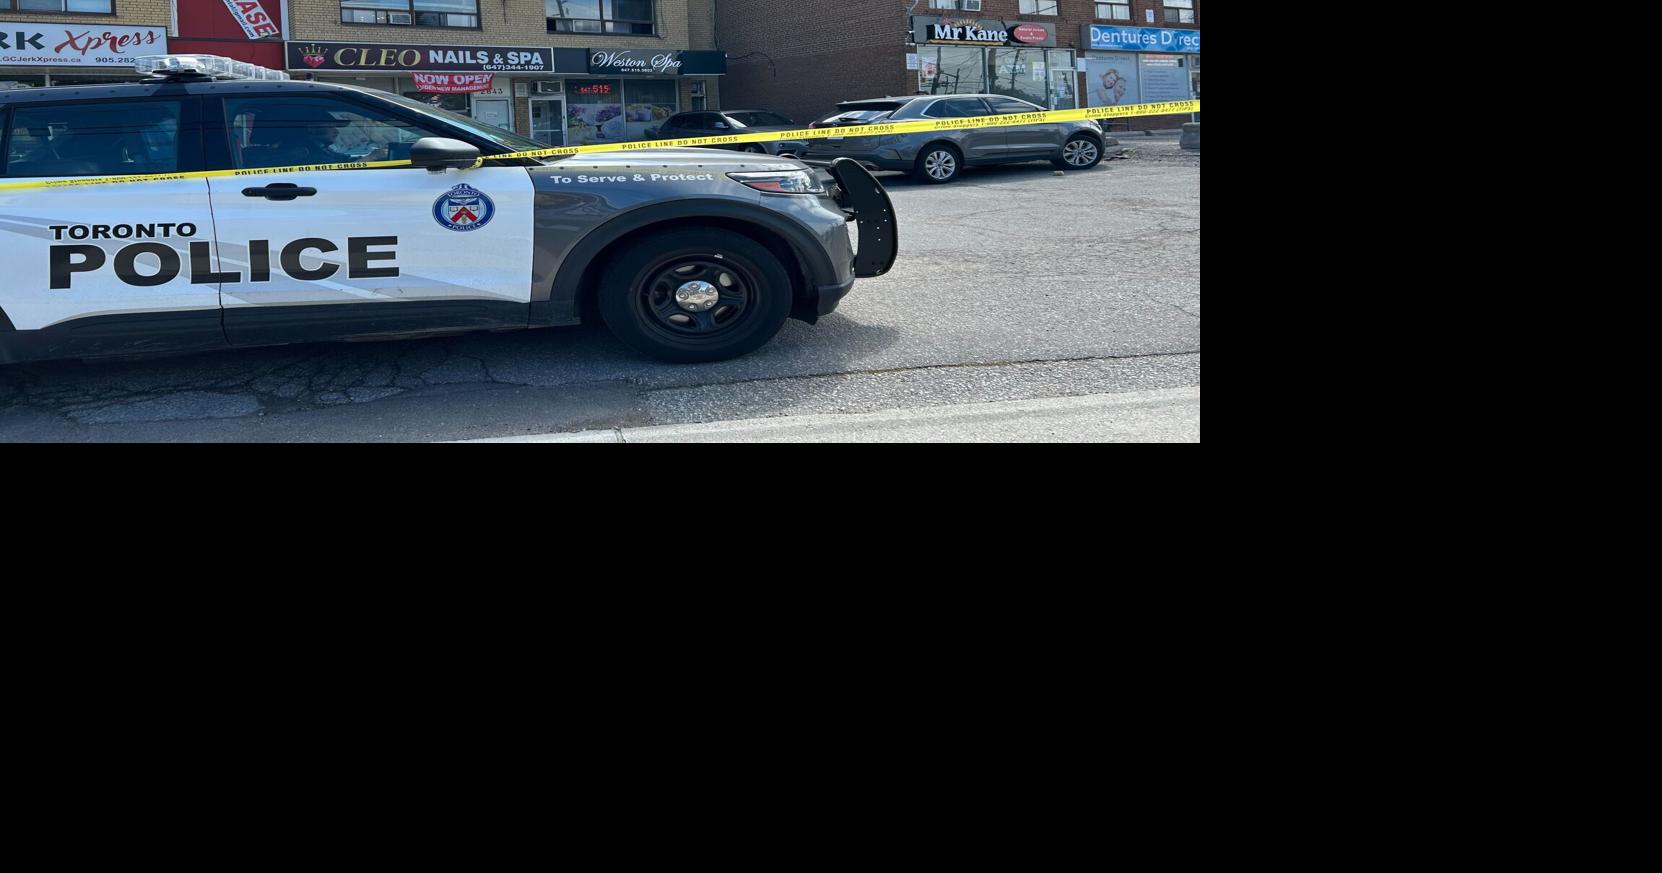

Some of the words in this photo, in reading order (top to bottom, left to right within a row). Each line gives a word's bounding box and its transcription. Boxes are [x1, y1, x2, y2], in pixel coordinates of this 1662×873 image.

[934, 24, 962, 40] Mr
[965, 25, 1008, 41] Kane
[1091, 27, 1157, 44] Dentures
[54, 30, 161, 56] Xpress
[334, 48, 421, 67] CLEO
[429, 50, 489, 64] NAILS
[493, 54, 504, 64] &
[507, 51, 544, 65] SPA
[592, 50, 646, 68] Weston
[651, 53, 682, 72] Spa
[414, 73, 448, 85] NOW
[453, 73, 493, 84] OPEN
[550, 176, 572, 184] To
[578, 175, 626, 183] Serve
[49, 223, 197, 240] TORONTO
[50, 236, 400, 289] POLICE
